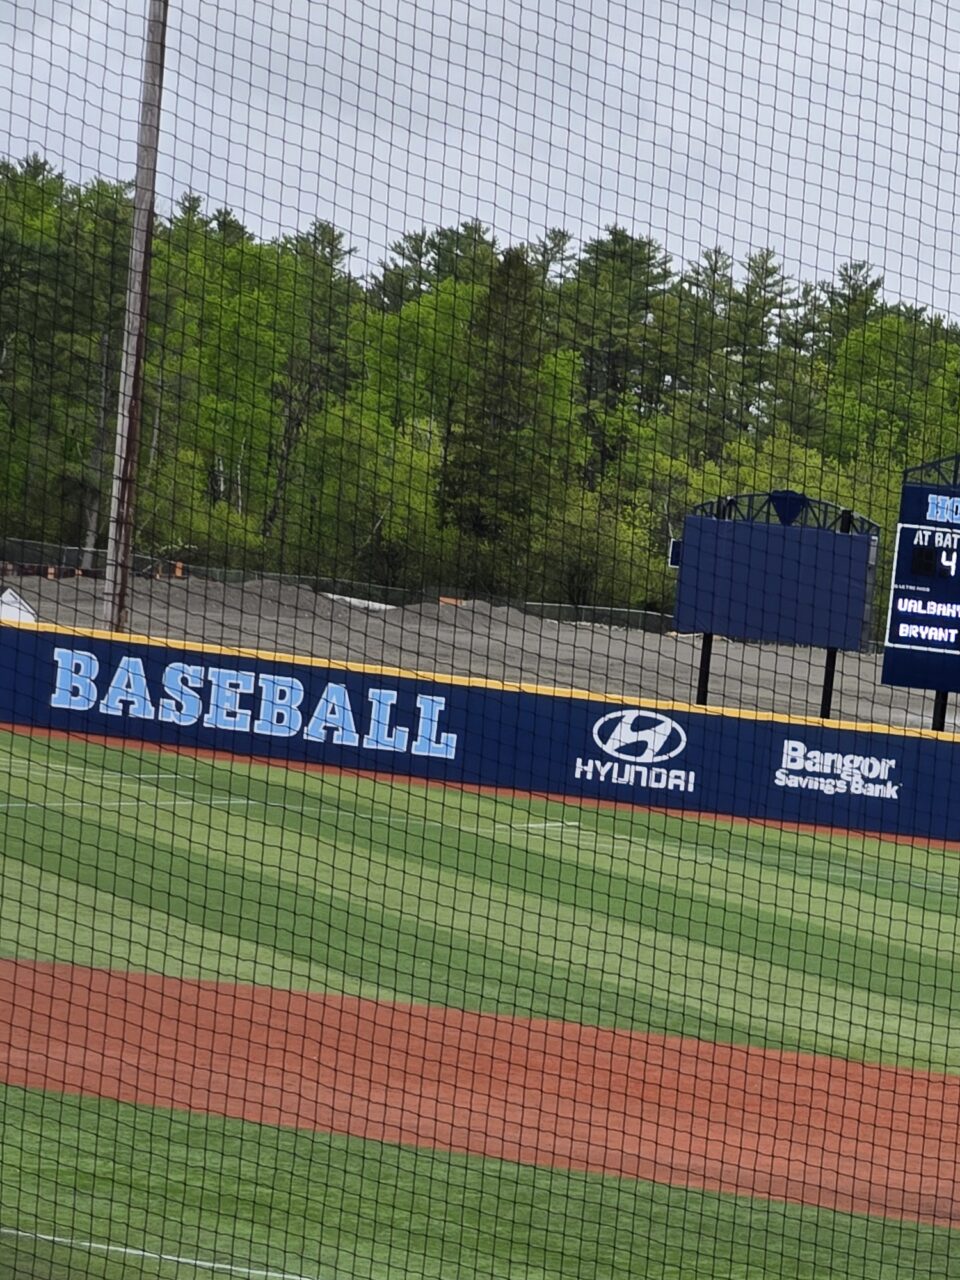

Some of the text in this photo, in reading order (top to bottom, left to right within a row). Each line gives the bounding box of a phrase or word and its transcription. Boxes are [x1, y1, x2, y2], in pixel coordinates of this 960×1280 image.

[913, 530, 960, 549] AT BAT
[941, 551, 957, 576] 4
[898, 623, 958, 642] BRYANT
[50, 648, 457, 759] BASEBALL
[574, 757, 695, 792] HYUNDAI
[781, 739, 896, 782] Bangor
[774, 768, 899, 799] Savings Bank
